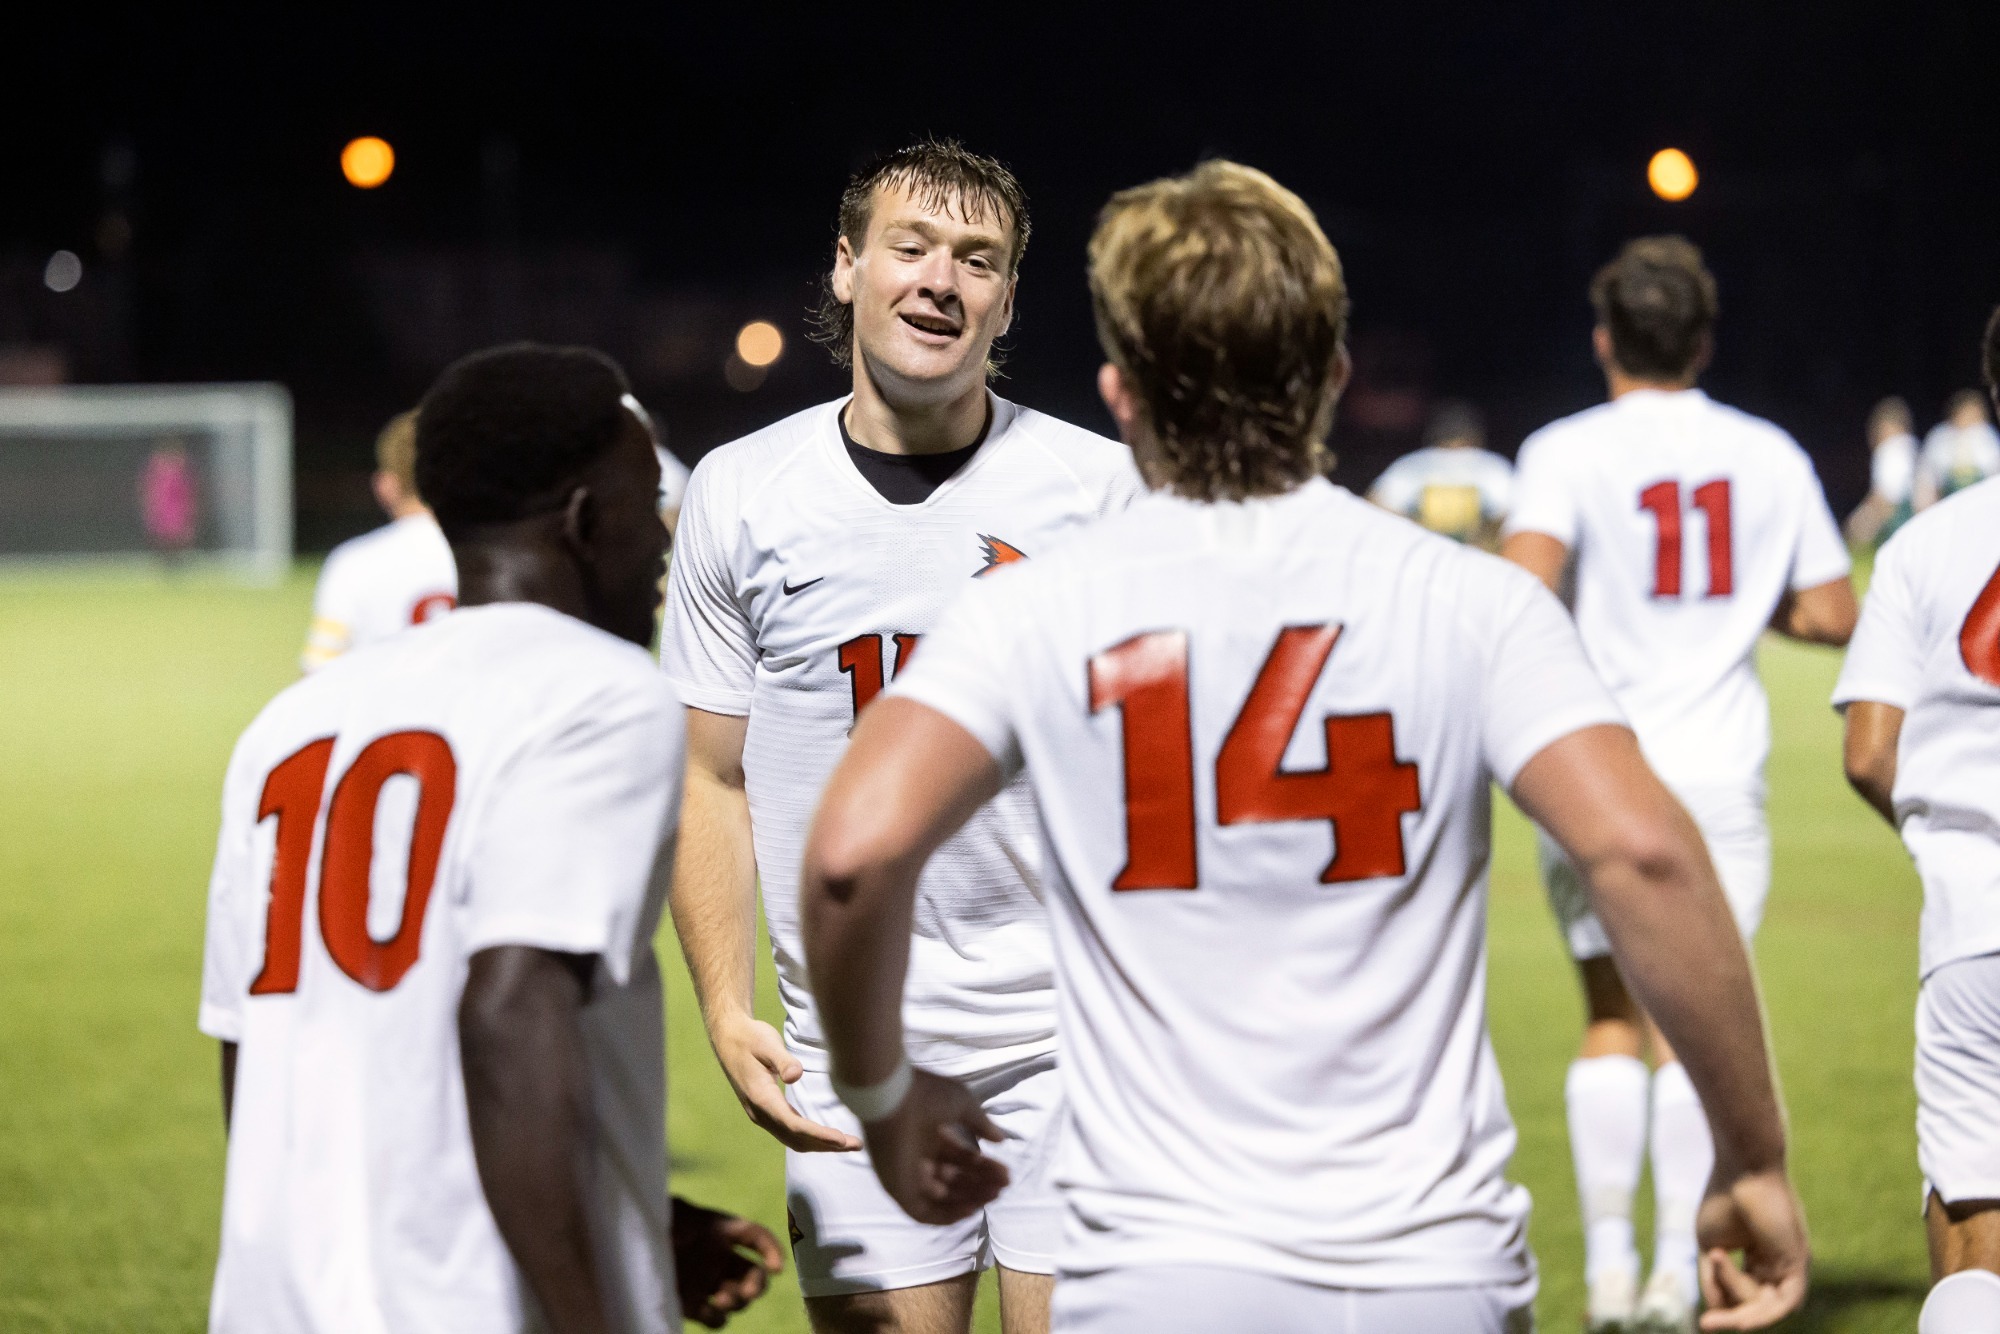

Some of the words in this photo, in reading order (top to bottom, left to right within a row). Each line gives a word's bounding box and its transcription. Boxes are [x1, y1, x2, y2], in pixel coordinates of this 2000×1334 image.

[1639, 479, 1734, 597] 11
[838, 633, 924, 739] 1
[1086, 623, 1422, 892] 14
[249, 729, 457, 995] 10
